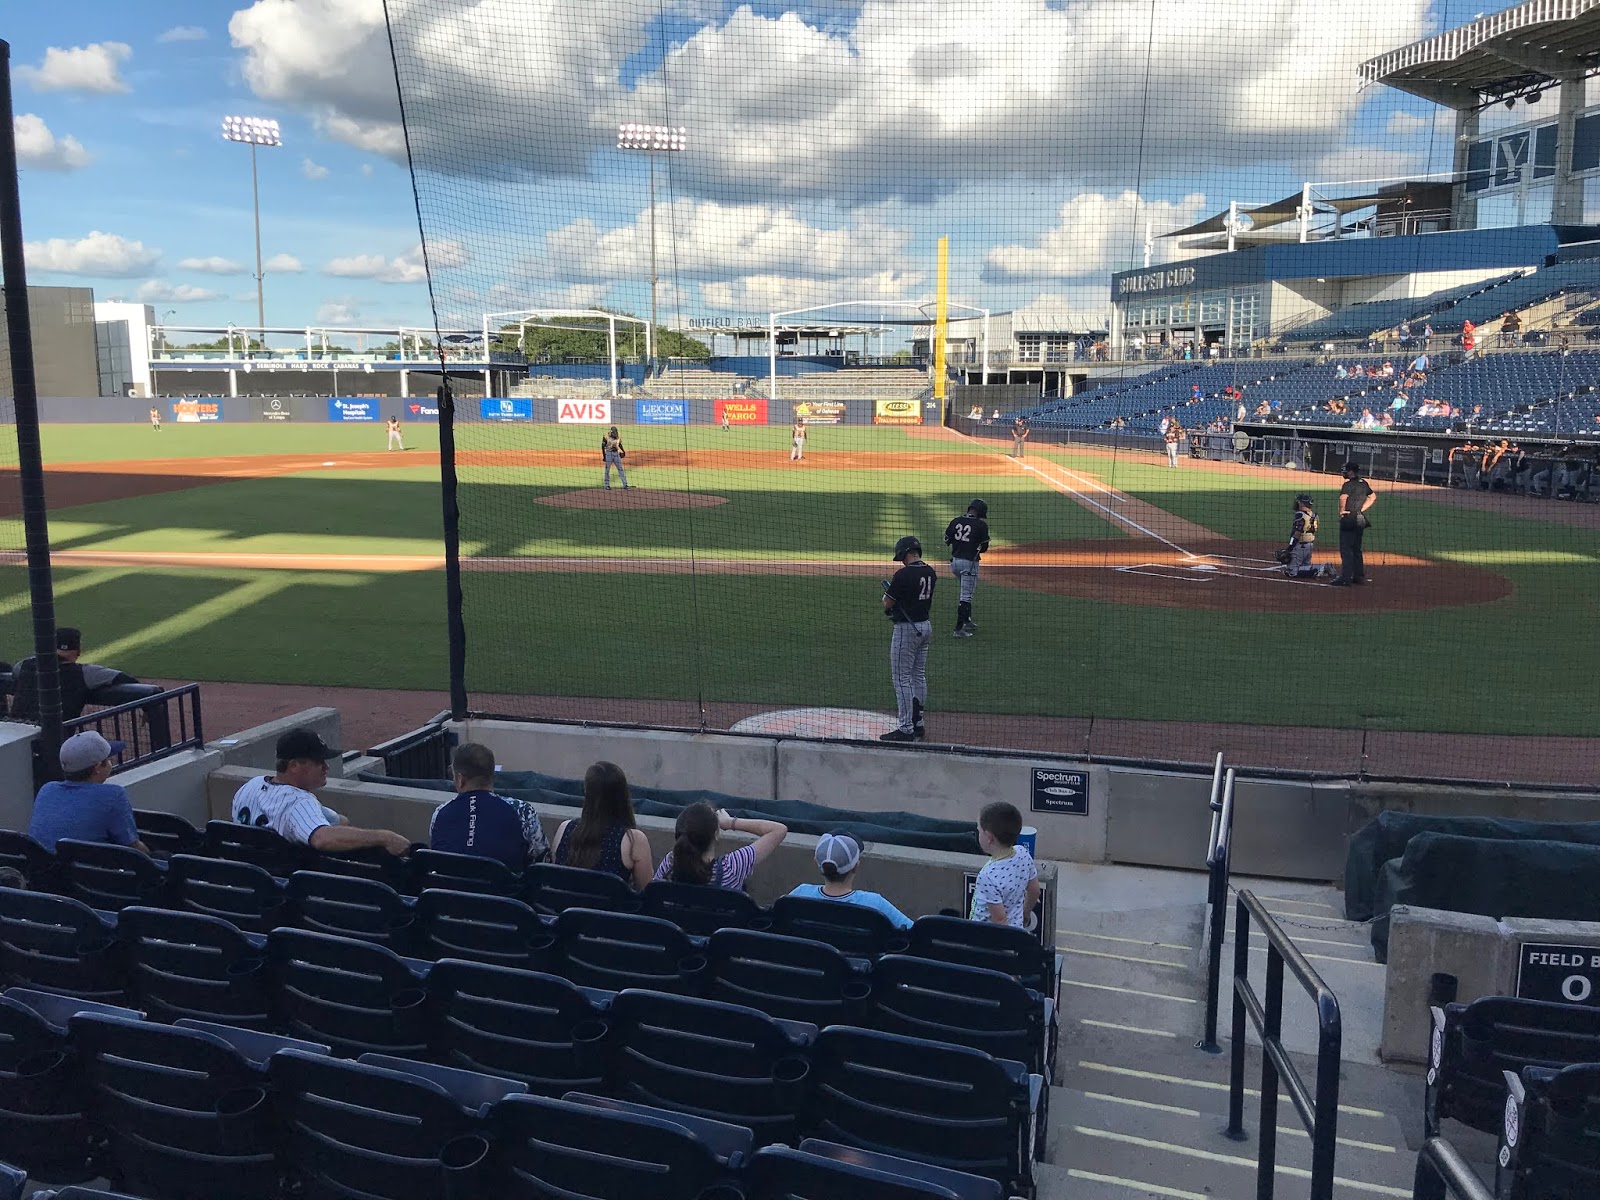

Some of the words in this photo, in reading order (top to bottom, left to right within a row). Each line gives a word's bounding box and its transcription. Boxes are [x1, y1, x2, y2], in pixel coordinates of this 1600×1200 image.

[1499, 136, 1528, 181] Y
[1119, 272, 1164, 294] BULLPEN
[1166, 267, 1195, 287] CLUB
[688, 317, 731, 328] OUTFIELD
[737, 317, 761, 329] BAR
[173, 403, 218, 413] HOOTERS
[560, 403, 606, 419] AVIS
[642, 404, 683, 413] LECOM
[725, 404, 757, 412] WELLS
[954, 523, 972, 542] 32
[919, 576, 932, 600] 21
[1036, 771, 1081, 782] Spectrum
[469, 795, 477, 813] Huk
[466, 814, 477, 847] Fishing
[1529, 952, 1585, 967] FIELD
